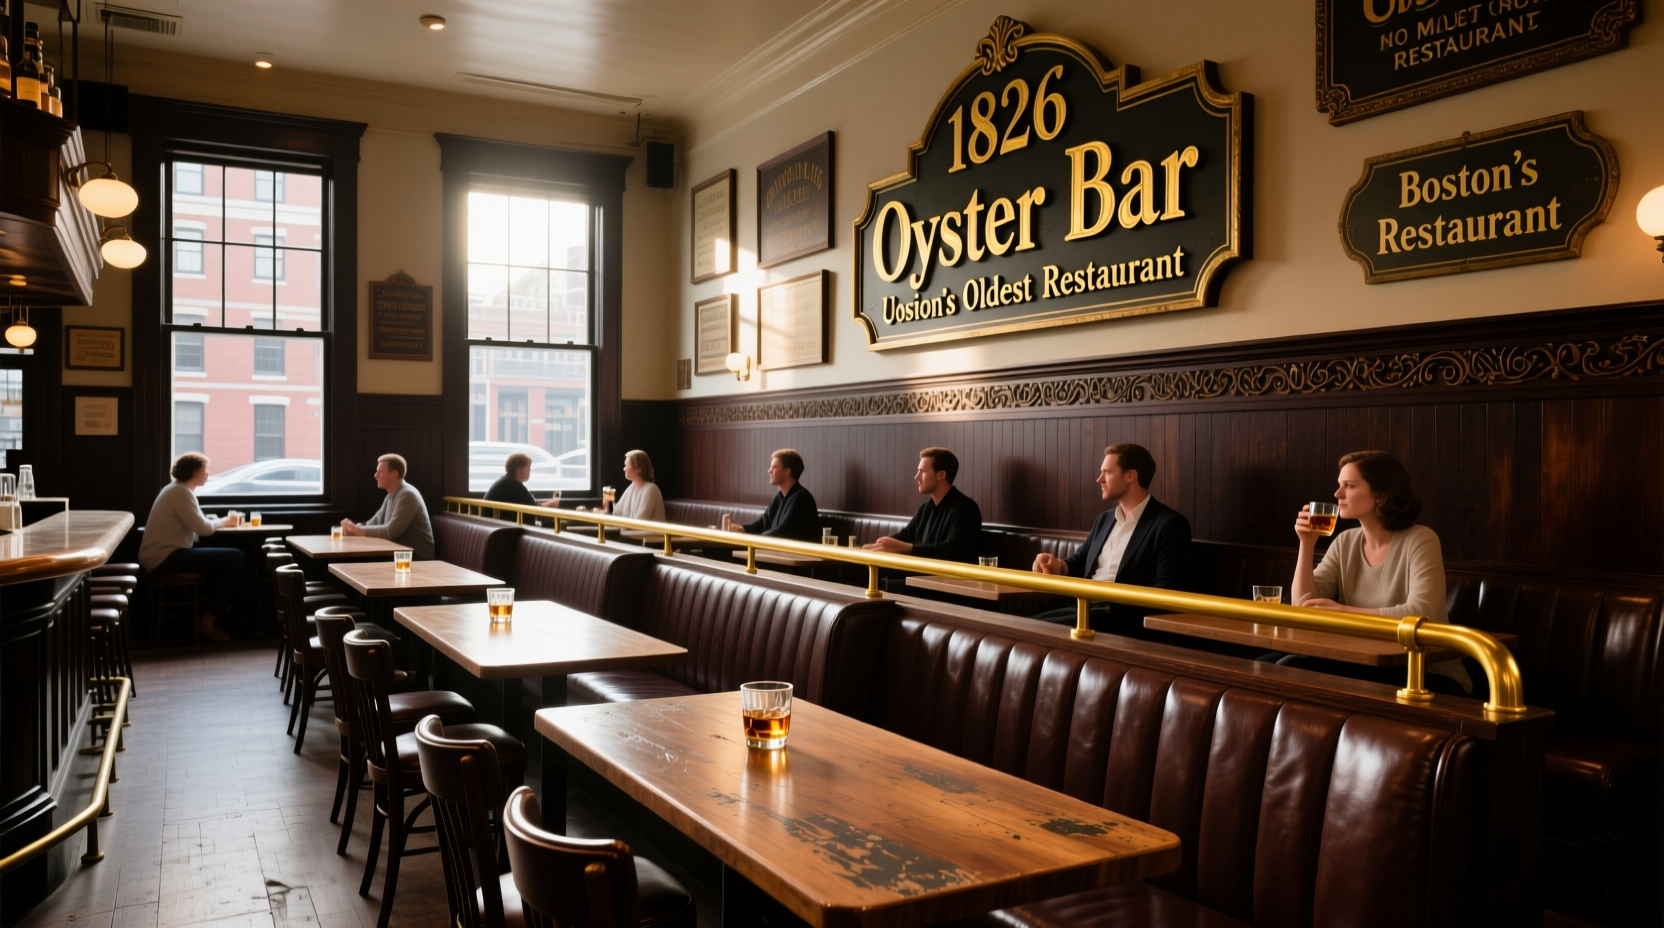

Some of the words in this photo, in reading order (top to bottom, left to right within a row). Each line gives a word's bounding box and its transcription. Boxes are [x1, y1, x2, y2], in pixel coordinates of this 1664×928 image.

[1380, 28, 1408, 51] NO
[948, 65, 1066, 173] 1826
[1399, 150, 1538, 208] Boston's
[873, 187, 1045, 289] Oyster
[1064, 141, 1198, 241] Bar
[1377, 196, 1561, 255] Restaurant
[963, 273, 1032, 310] Oldest
[1043, 246, 1184, 298] Restaurant
